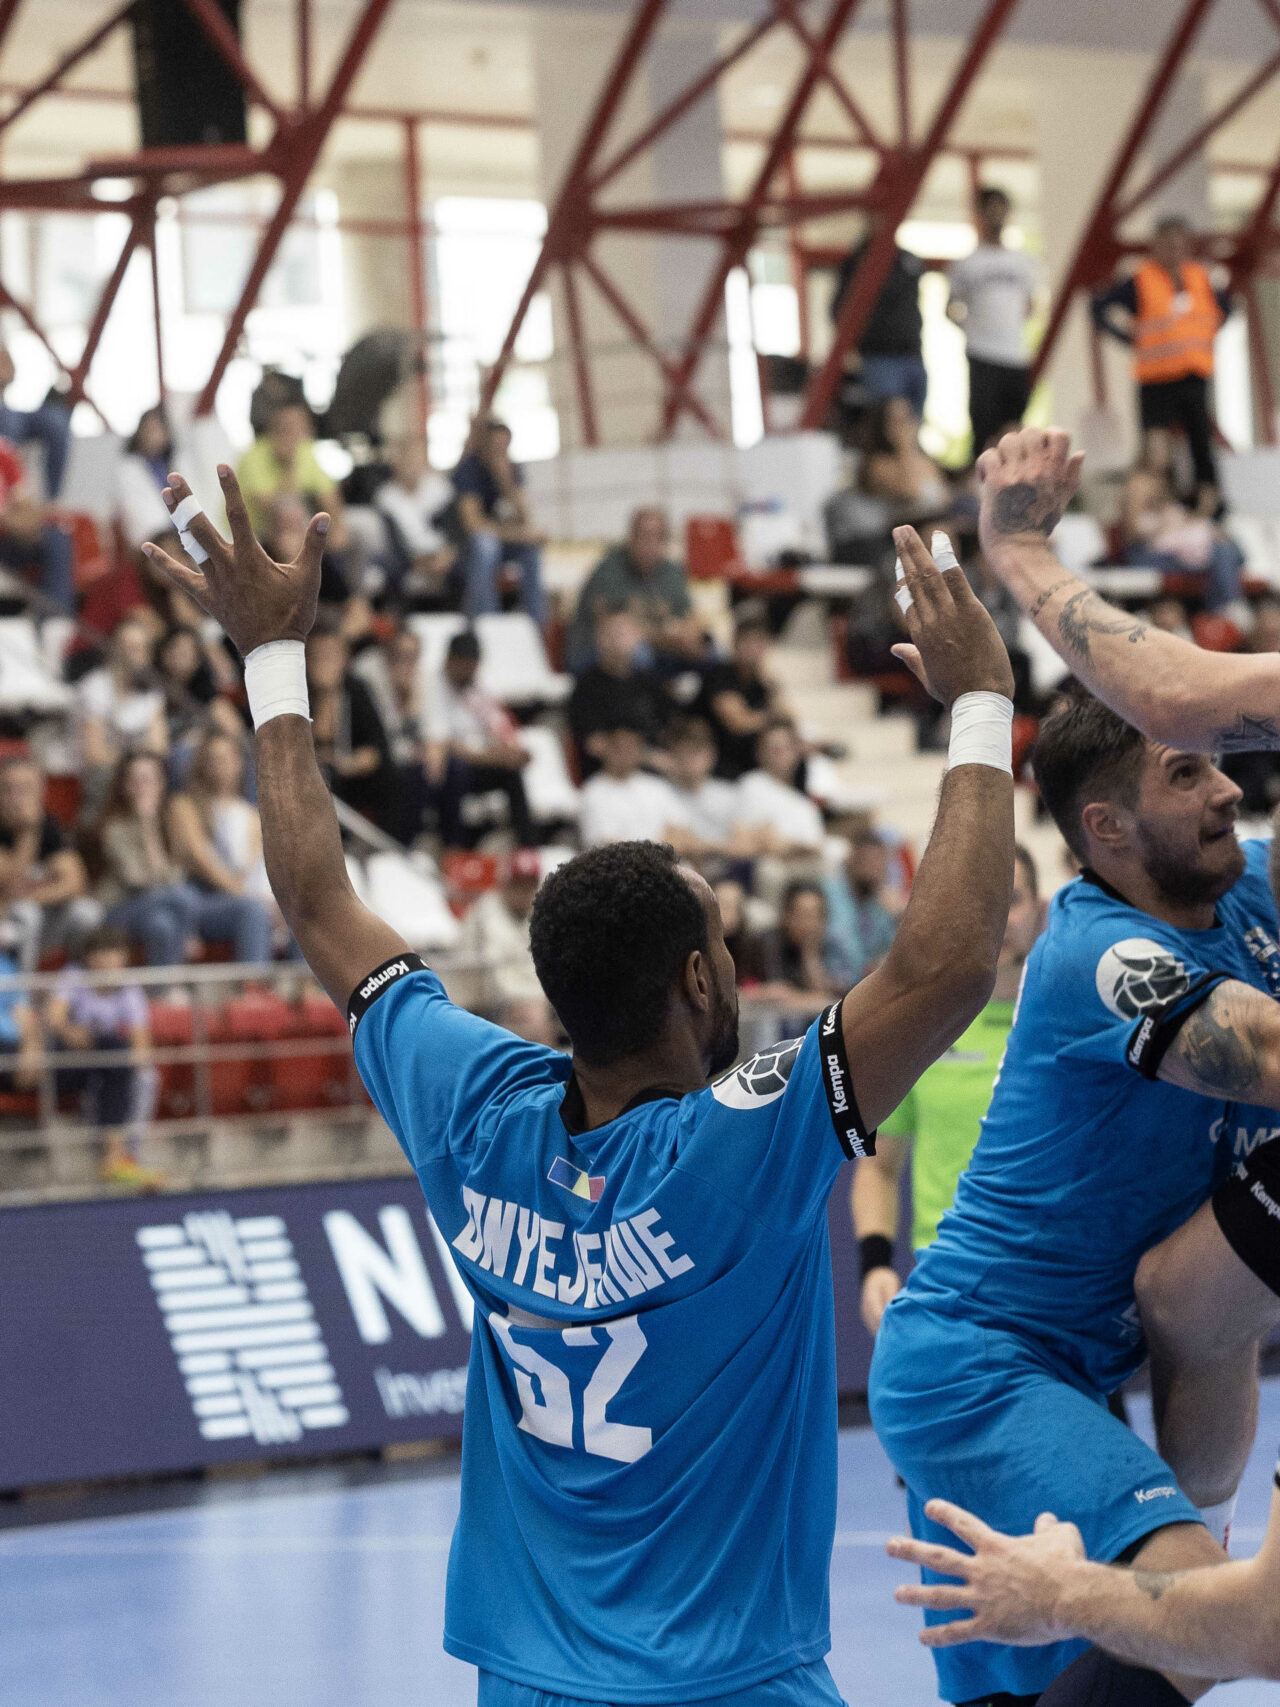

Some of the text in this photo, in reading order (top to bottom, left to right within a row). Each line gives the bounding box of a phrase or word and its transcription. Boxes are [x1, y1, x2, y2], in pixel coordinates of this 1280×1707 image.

[359, 960, 410, 999] Kempa
[1127, 1017, 1155, 1066] Kempa
[826, 1054, 849, 1115] Kempa
[845, 1127, 867, 1160] empa
[488, 1304, 653, 1464] 52
[1134, 1485, 1177, 1504] Kempa
